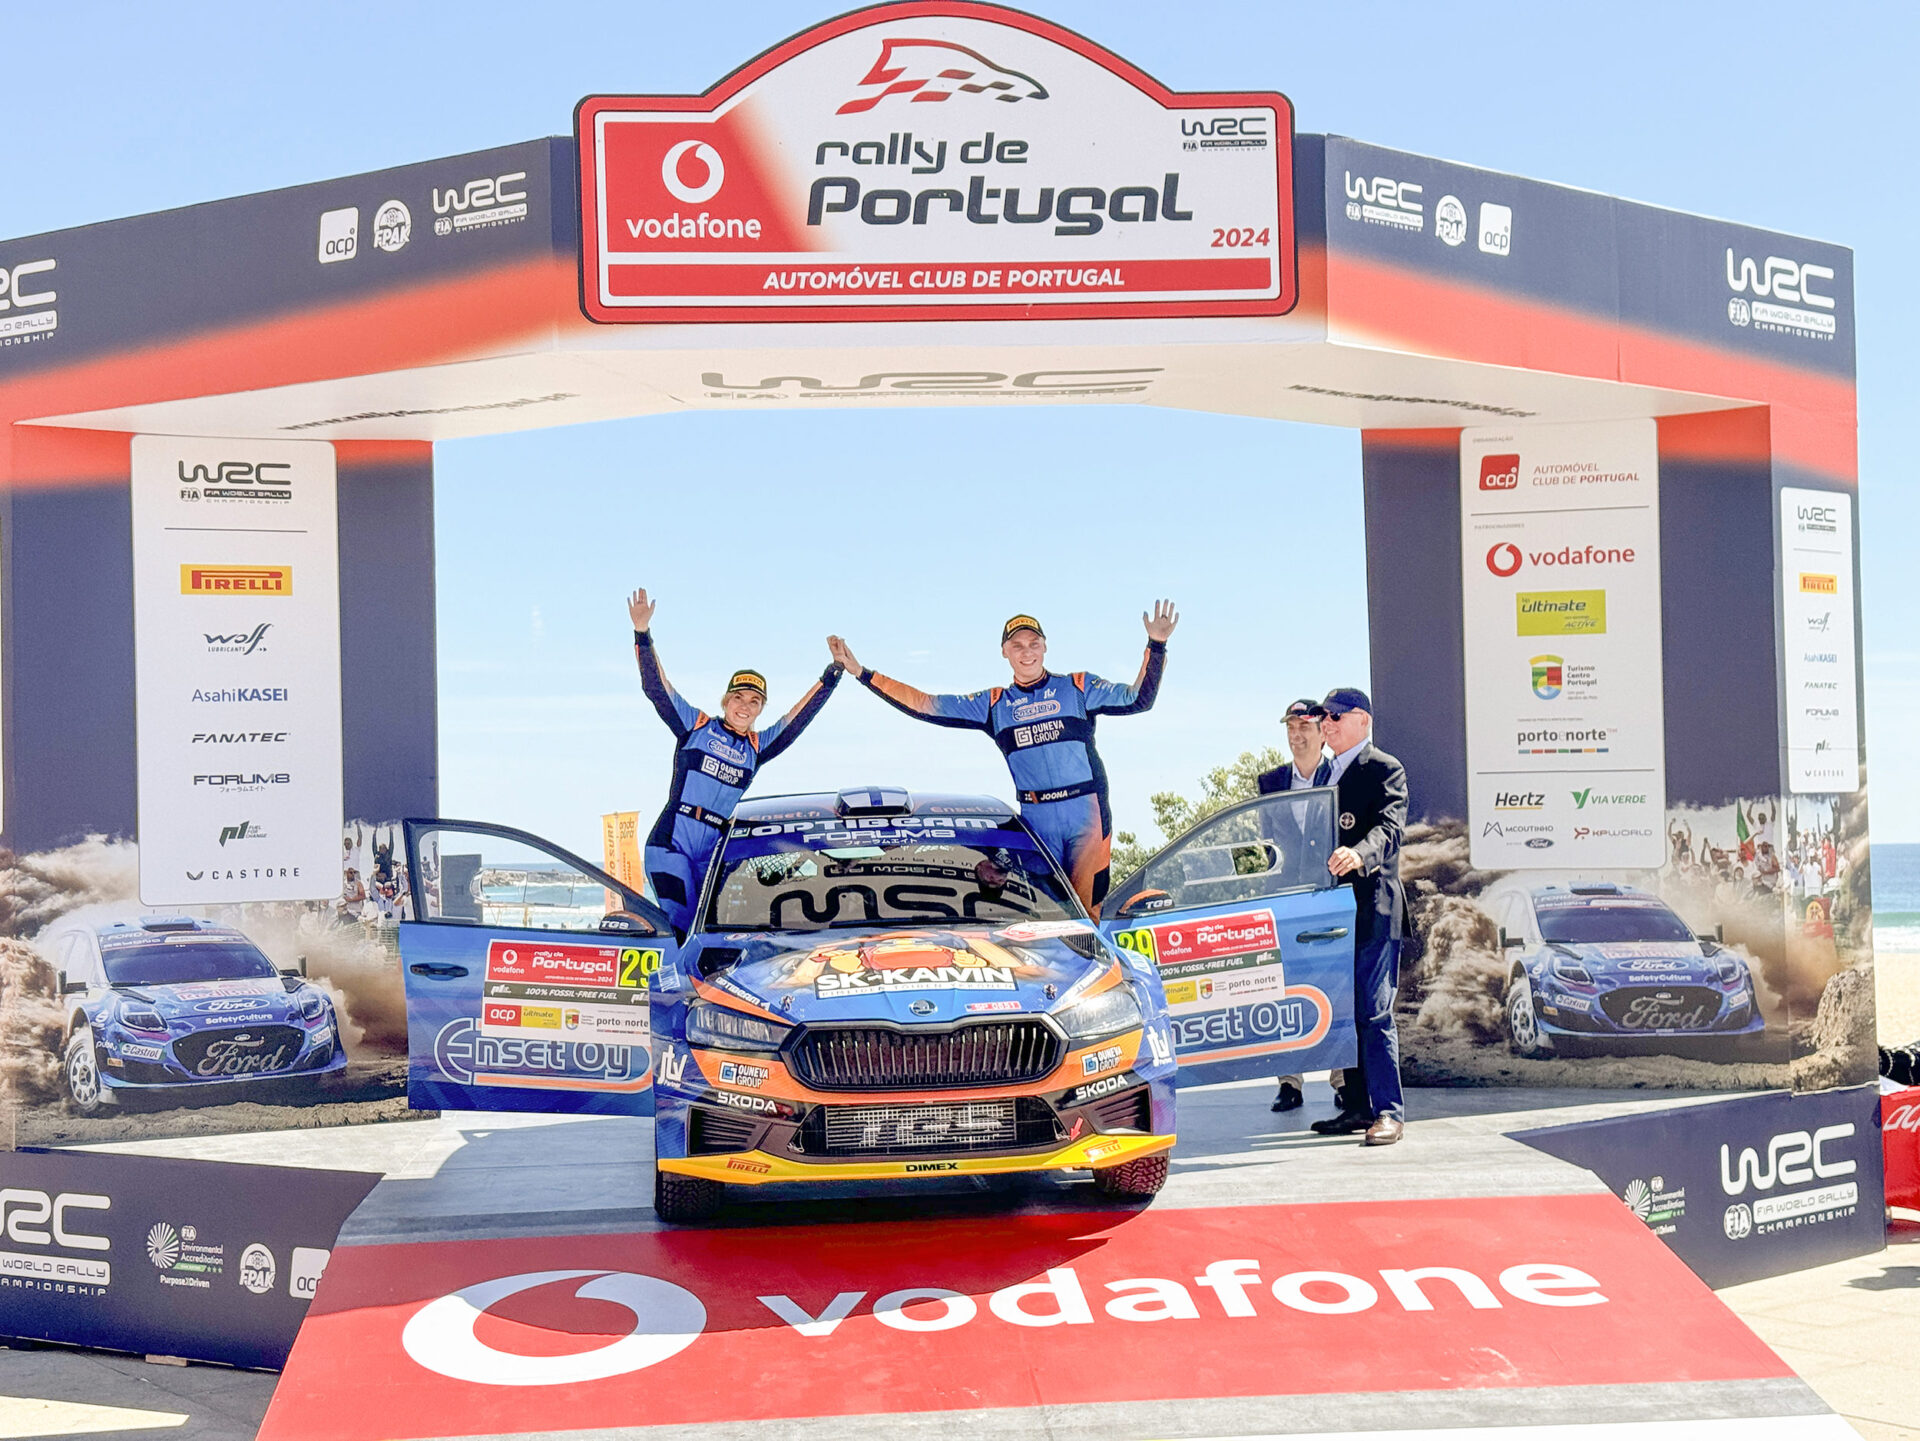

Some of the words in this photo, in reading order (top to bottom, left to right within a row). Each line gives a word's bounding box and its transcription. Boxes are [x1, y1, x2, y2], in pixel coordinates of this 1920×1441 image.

[1182, 118, 1266, 135] WRC
[815, 132, 946, 174] rally
[959, 132, 1028, 165] de
[432, 171, 526, 214] WRC
[1345, 170, 1423, 212] WRC
[806, 173, 1194, 237] Portugal
[456, 217, 526, 233] CHAMPIONSHIP
[469, 211, 497, 223] WORLD
[625, 212, 762, 240] vodafone
[373, 227, 411, 249] FPAK
[1210, 228, 1270, 248] 2024
[1484, 231, 1509, 249] acp
[326, 237, 355, 256] acp
[763, 266, 903, 290] AUTOMÓVEL
[908, 269, 968, 288] CLUB
[974, 269, 1003, 287] DE
[1008, 267, 1125, 287] PORTUGAL
[1727, 248, 1835, 309] WRC
[15, 315, 54, 330] RALLY
[1755, 322, 1834, 341] CHAMPIONSHIP
[178, 460, 291, 485] WRC
[1534, 462, 1599, 474] AUTOMÓVEL
[1486, 472, 1517, 488] acp
[1532, 476, 1560, 487] CLUB
[1562, 476, 1576, 485] DE
[1579, 472, 1640, 484] PORTUGAL
[180, 489, 199, 500] FIA
[1529, 546, 1636, 567] vodafone
[191, 570, 283, 591] PIRELLI
[1803, 576, 1834, 591] PIRELLI
[1521, 600, 1587, 613] ultimate
[1567, 679, 1598, 687] Portugal
[1032, 720, 1065, 734] OUNEVA
[192, 732, 288, 743] FANATEC
[1033, 730, 1060, 744] GROUP
[193, 773, 291, 786] FORUM8
[1040, 789, 1068, 801] JOONA
[1495, 792, 1545, 807] Hertz
[1591, 795, 1609, 805] VIA
[1611, 794, 1647, 804] VERDE
[803, 829, 956, 844] FORUM8
[1505, 825, 1554, 833] MCOUTINHO
[212, 867, 301, 880] CASTORE
[1197, 923, 1272, 945] Portugal
[1162, 946, 1193, 957] vodafone
[492, 966, 525, 975] vodafone
[532, 956, 614, 974] Portugal
[619, 948, 659, 987] 29
[1160, 966, 1181, 977] 100%
[1181, 959, 1225, 974] FOSSIL-FREE
[1226, 957, 1244, 967] FUEL
[1631, 959, 1676, 971] Ford
[1628, 974, 1692, 983] SafetyCulture
[525, 988, 548, 996] 100%
[549, 989, 599, 1000] FOSSIL-FREE
[600, 992, 618, 1000] FUEL
[208, 999, 258, 1011] Ford
[1622, 997, 1704, 1029] Ford
[205, 1013, 273, 1025] SafetyCulture
[490, 1008, 516, 1022] acp
[1251, 1002, 1304, 1041] Oy
[130, 1046, 159, 1058] Castrol
[197, 1038, 286, 1076] Ford
[572, 1042, 632, 1081] Oy
[1099, 1057, 1121, 1072] GROUP
[738, 1064, 769, 1079] OUNEVA
[736, 1075, 763, 1089] GROUP
[726, 1157, 772, 1174] PIRELLI
[1720, 1122, 1857, 1195] WRC
[905, 1162, 960, 1172] DIMEX
[1756, 1203, 1774, 1217] FIA
[1776, 1197, 1816, 1213] WORLD
[1818, 1188, 1855, 1204] RALLY
[1757, 1206, 1856, 1235] CHAMPIONSHIP
[181, 1241, 224, 1255] Environmental
[180, 1252, 224, 1266] Accreditation
[2, 1259, 53, 1272] WORLD
[56, 1264, 107, 1278] RALLY
[0, 1278, 107, 1296] AMPIONSHIP
[239, 1269, 277, 1289] FPAK
[757, 1259, 1609, 1339] vodafone
